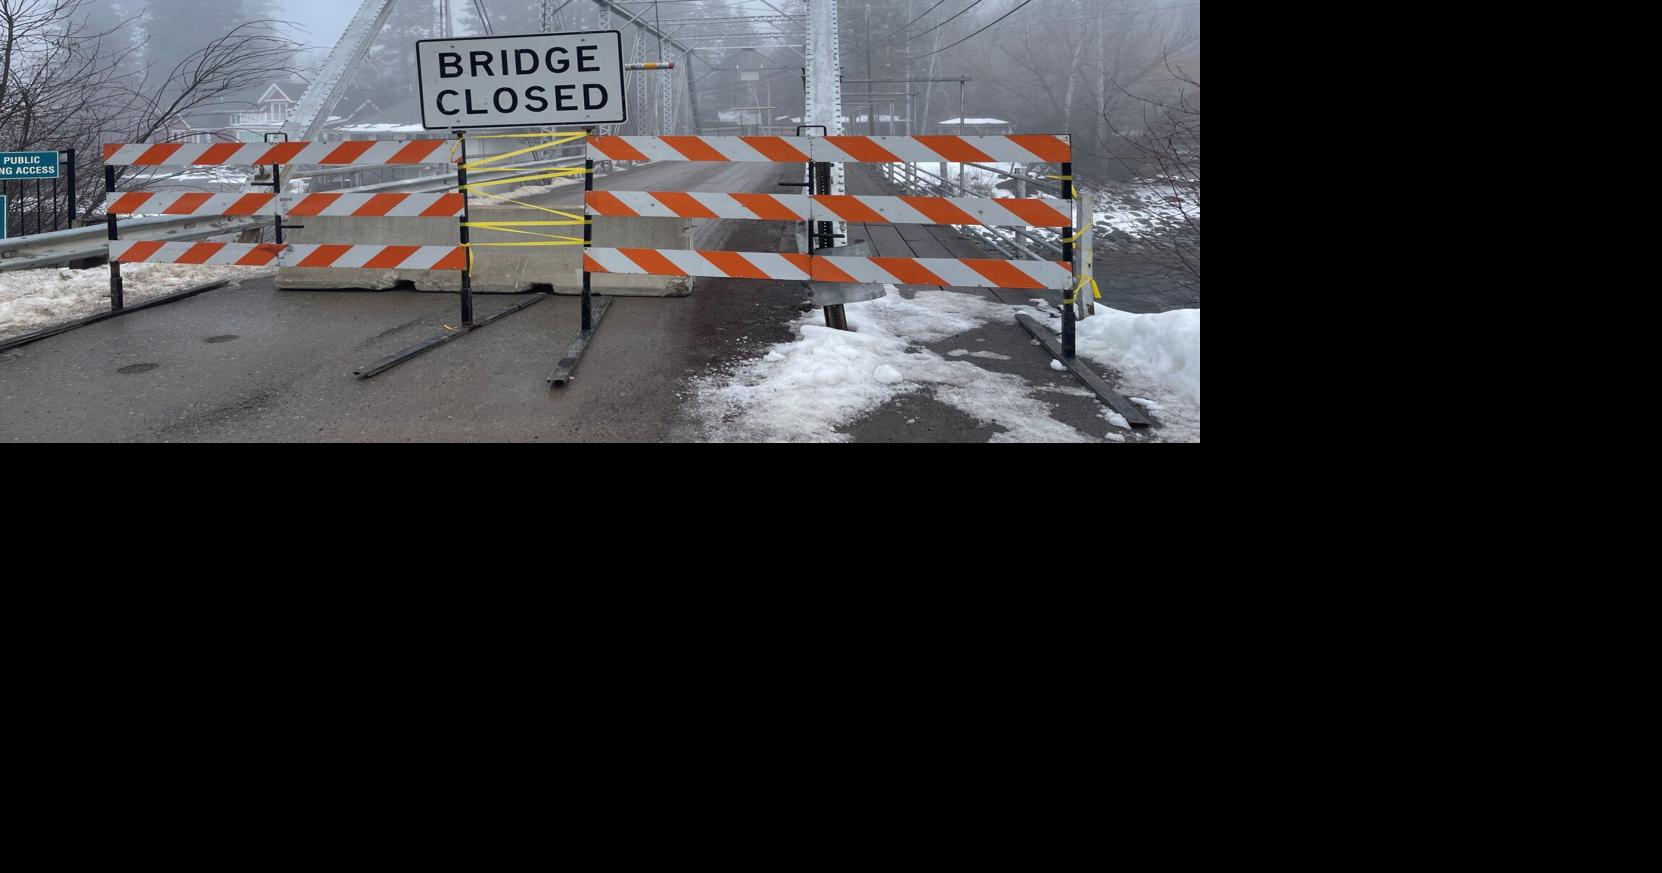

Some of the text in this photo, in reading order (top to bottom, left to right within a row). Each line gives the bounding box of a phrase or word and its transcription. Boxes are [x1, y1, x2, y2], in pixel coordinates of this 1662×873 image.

[438, 45, 601, 79] BRIDGE
[436, 83, 609, 116] CLOSED
[3, 155, 41, 164] PUBLIC
[15, 166, 55, 175] ACCESS
